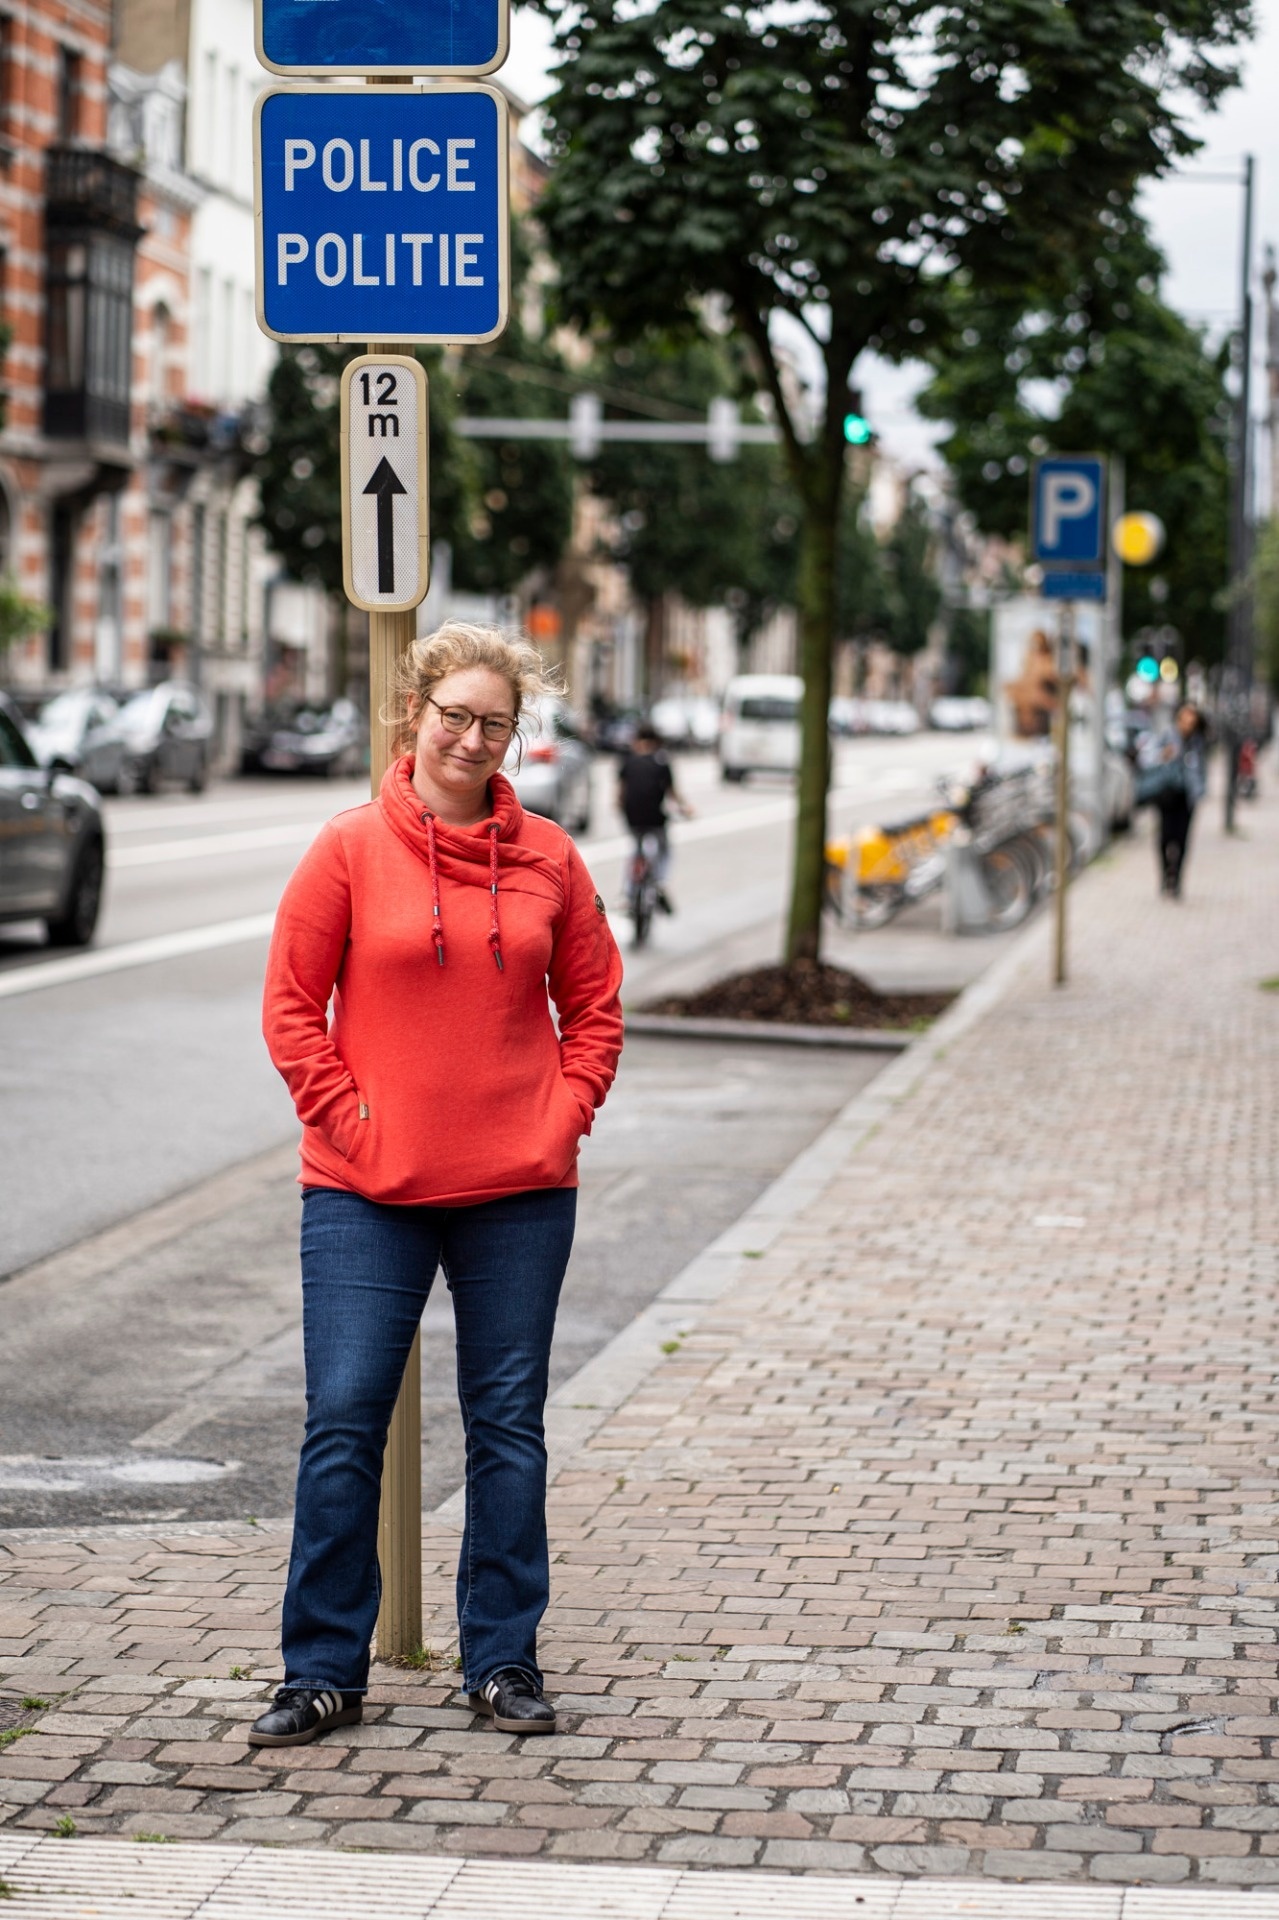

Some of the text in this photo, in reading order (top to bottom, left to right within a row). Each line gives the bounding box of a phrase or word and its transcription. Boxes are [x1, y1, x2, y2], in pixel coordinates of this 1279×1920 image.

[285, 138, 475, 192] POLICE
[278, 233, 484, 286] POLITIE
[359, 372, 398, 406] 12
[368, 413, 399, 437] m
[1042, 472, 1095, 549] P
